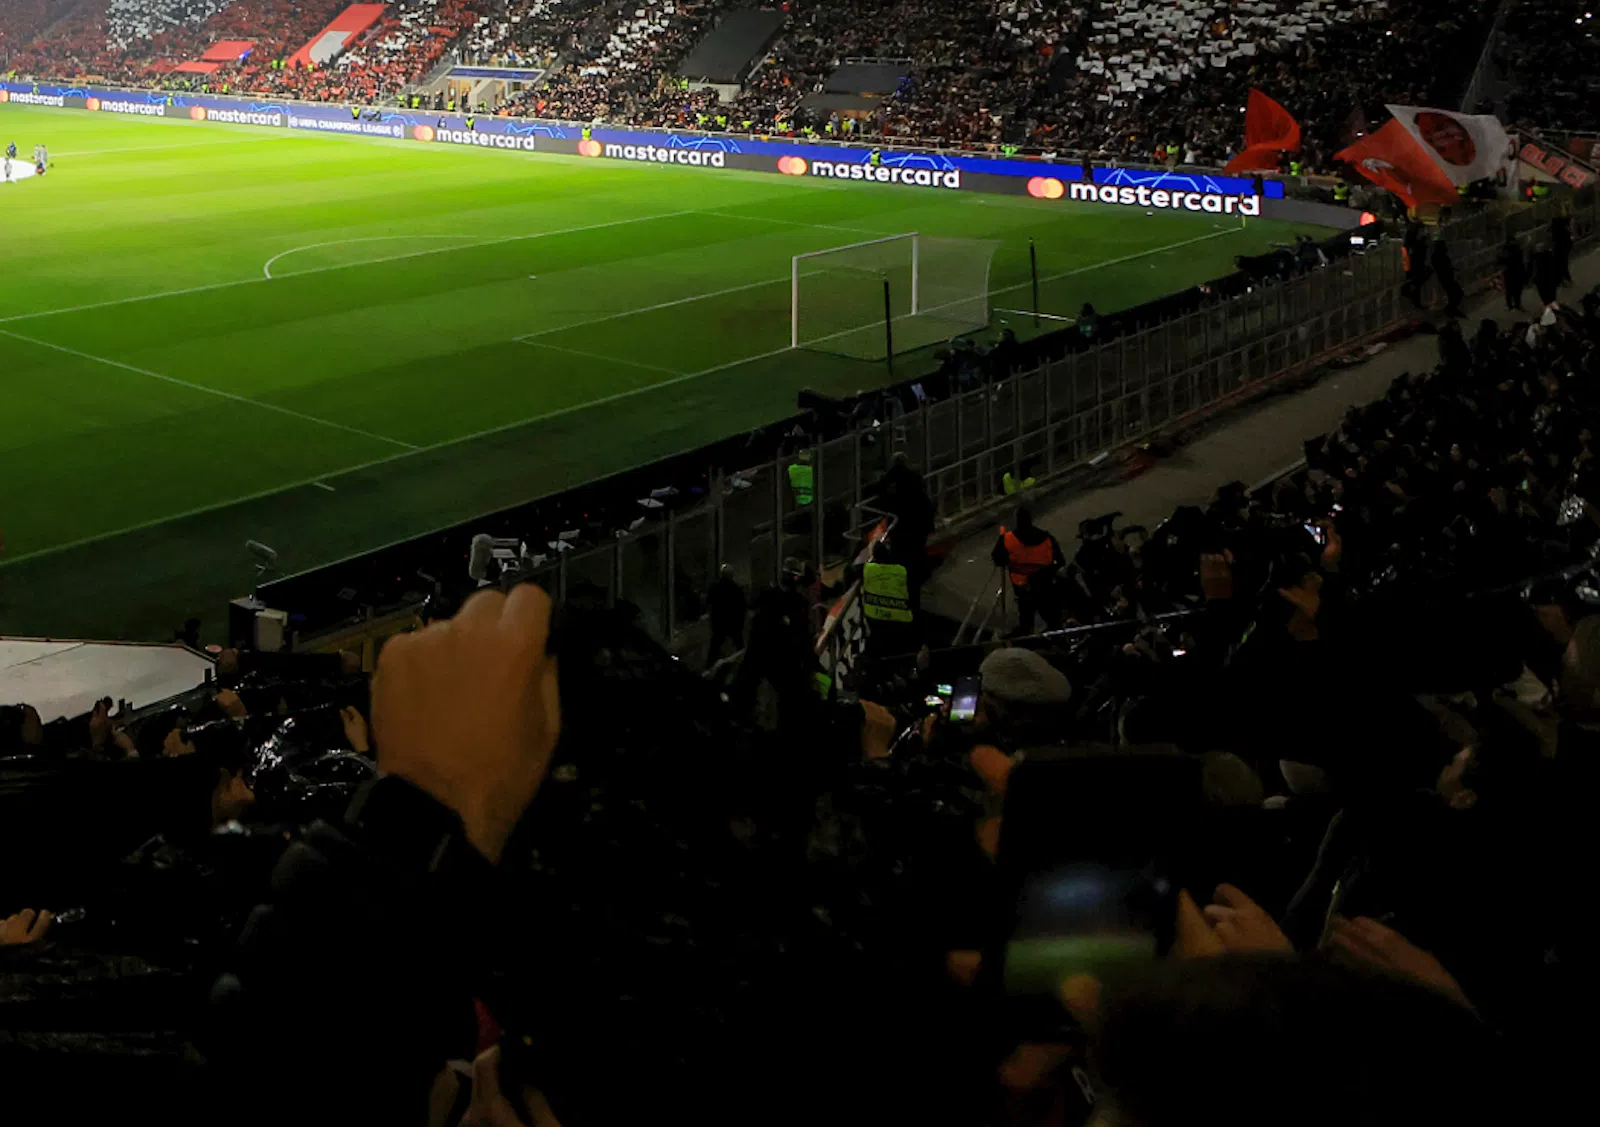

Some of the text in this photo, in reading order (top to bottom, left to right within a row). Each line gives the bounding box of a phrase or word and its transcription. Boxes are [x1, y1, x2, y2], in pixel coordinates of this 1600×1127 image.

[10, 92, 64, 107] mastercard
[101, 100, 165, 117] mastercard
[207, 108, 282, 127] mastercard
[298, 118, 392, 136] UEFA CHAMPIONS LEAGUE
[437, 128, 536, 151] mastercard
[605, 142, 725, 169] mastercard
[812, 158, 961, 190] mastercard
[1070, 181, 1261, 217] mastercard
